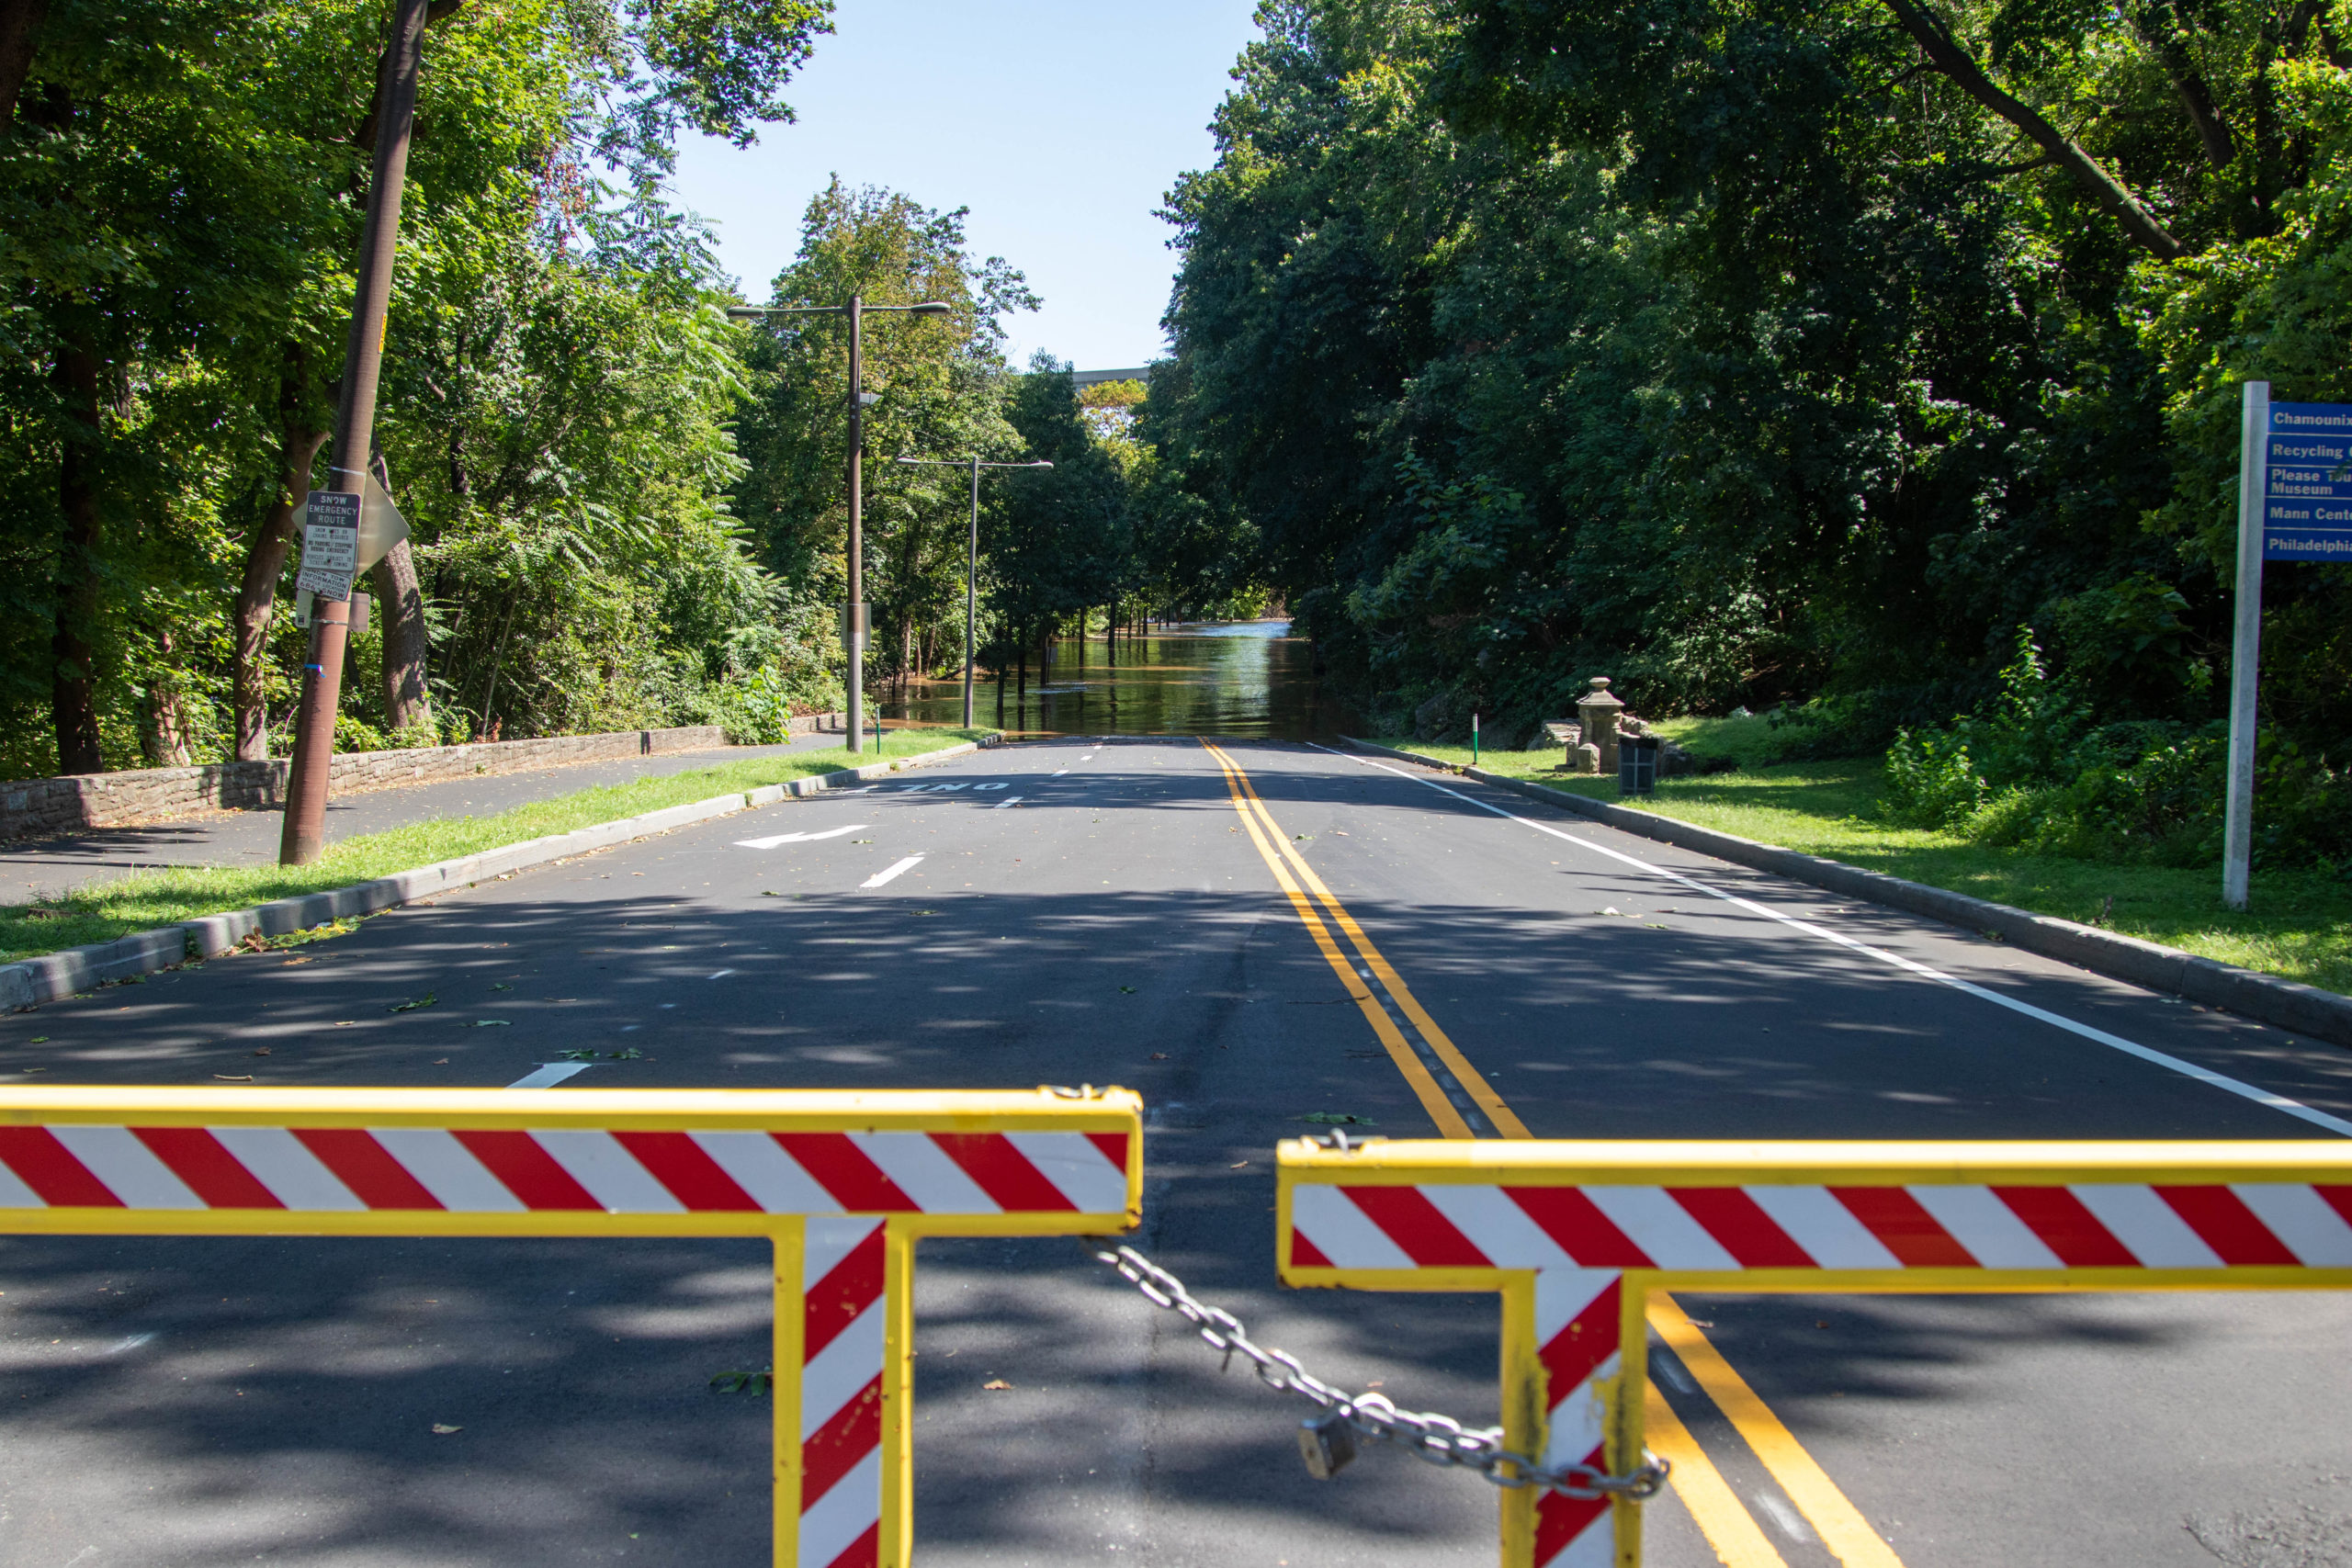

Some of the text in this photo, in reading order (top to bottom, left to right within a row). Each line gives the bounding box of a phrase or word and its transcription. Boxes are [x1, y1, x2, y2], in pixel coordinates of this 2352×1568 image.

[2274, 412, 2352, 426] Chamounix
[2273, 444, 2344, 459] Recycling
[2271, 468, 2320, 482] Please
[2271, 481, 2333, 495] Museum
[321, 495, 347, 505] SNOW
[309, 504, 357, 515] EMERGENCY
[2270, 506, 2310, 520] Mann
[318, 514, 346, 525] ROUTE
[302, 571, 347, 589] INFORMATION
